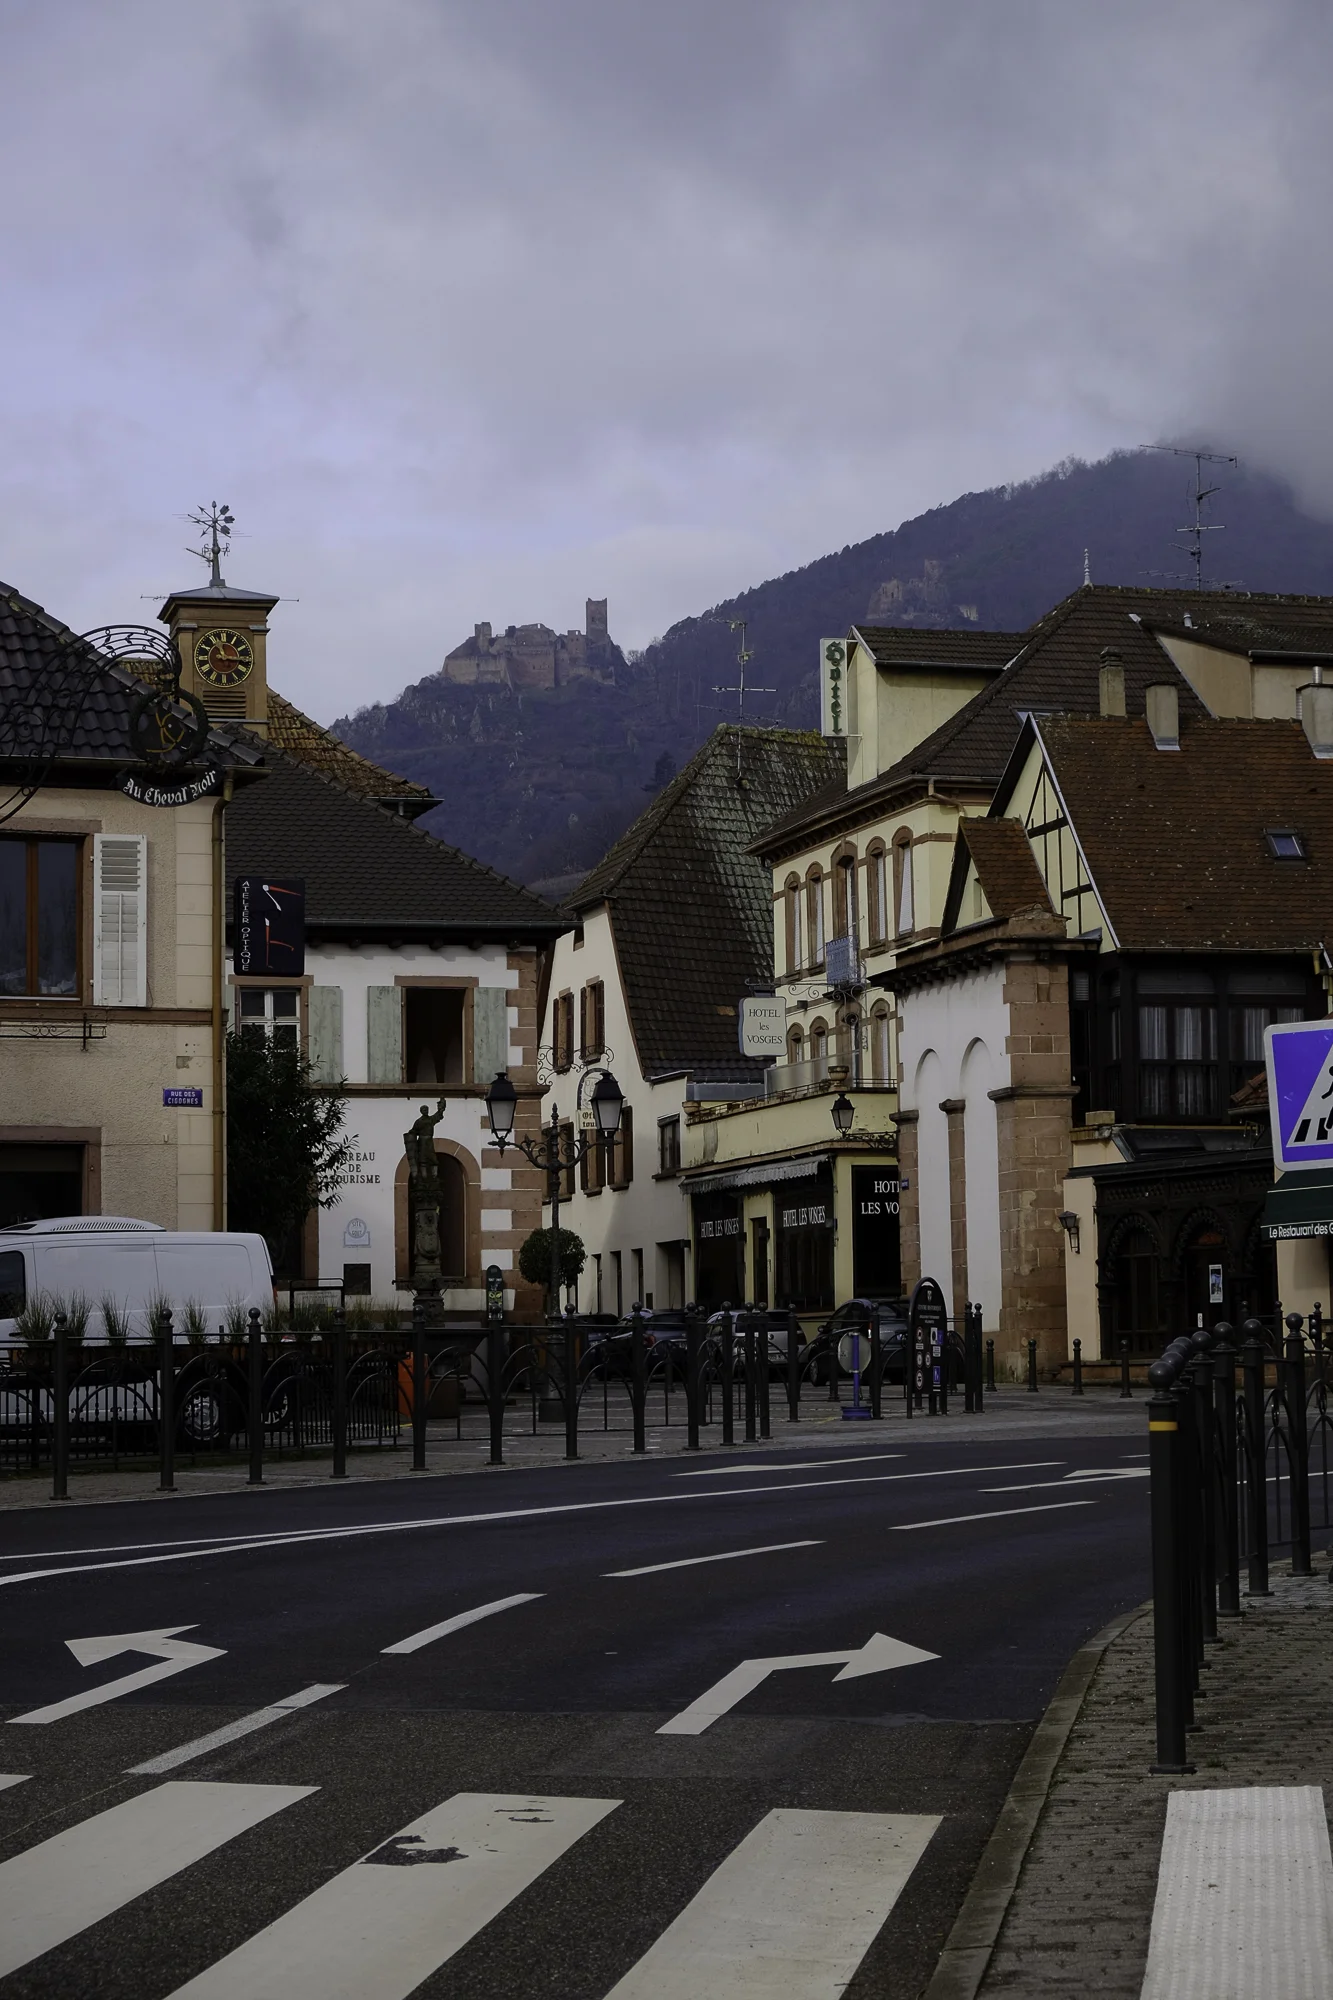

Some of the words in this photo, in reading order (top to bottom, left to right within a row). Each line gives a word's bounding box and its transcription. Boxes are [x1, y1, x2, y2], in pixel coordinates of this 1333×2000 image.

[123, 778, 141, 799] Au
[144, 787, 188, 807] Cheval
[190, 770, 216, 799] Noir
[242, 881, 250, 924] ATELIER
[240, 926, 251, 972] OPTIQUE
[749, 1008, 781, 1018] HOTEL
[759, 1021, 770, 1031] les
[747, 1034, 783, 1045] VOSGES
[341, 1152, 375, 1162] REAU
[348, 1163, 362, 1173] DE
[336, 1174, 381, 1184] OURISME
[861, 1201, 881, 1215] LES
[884, 1201, 900, 1215] VO
[783, 1209, 797, 1227] HOTEL
[799, 1208, 808, 1225] LES
[808, 1205, 826, 1224] VOSGES
[701, 1221, 714, 1238] HOTEL
[715, 1219, 723, 1236] LES
[724, 1217, 739, 1235] VOSGES
[1269, 1227, 1278, 1238] Le
[1279, 1224, 1313, 1237] Restaurant
[1314, 1223, 1328, 1235] des
